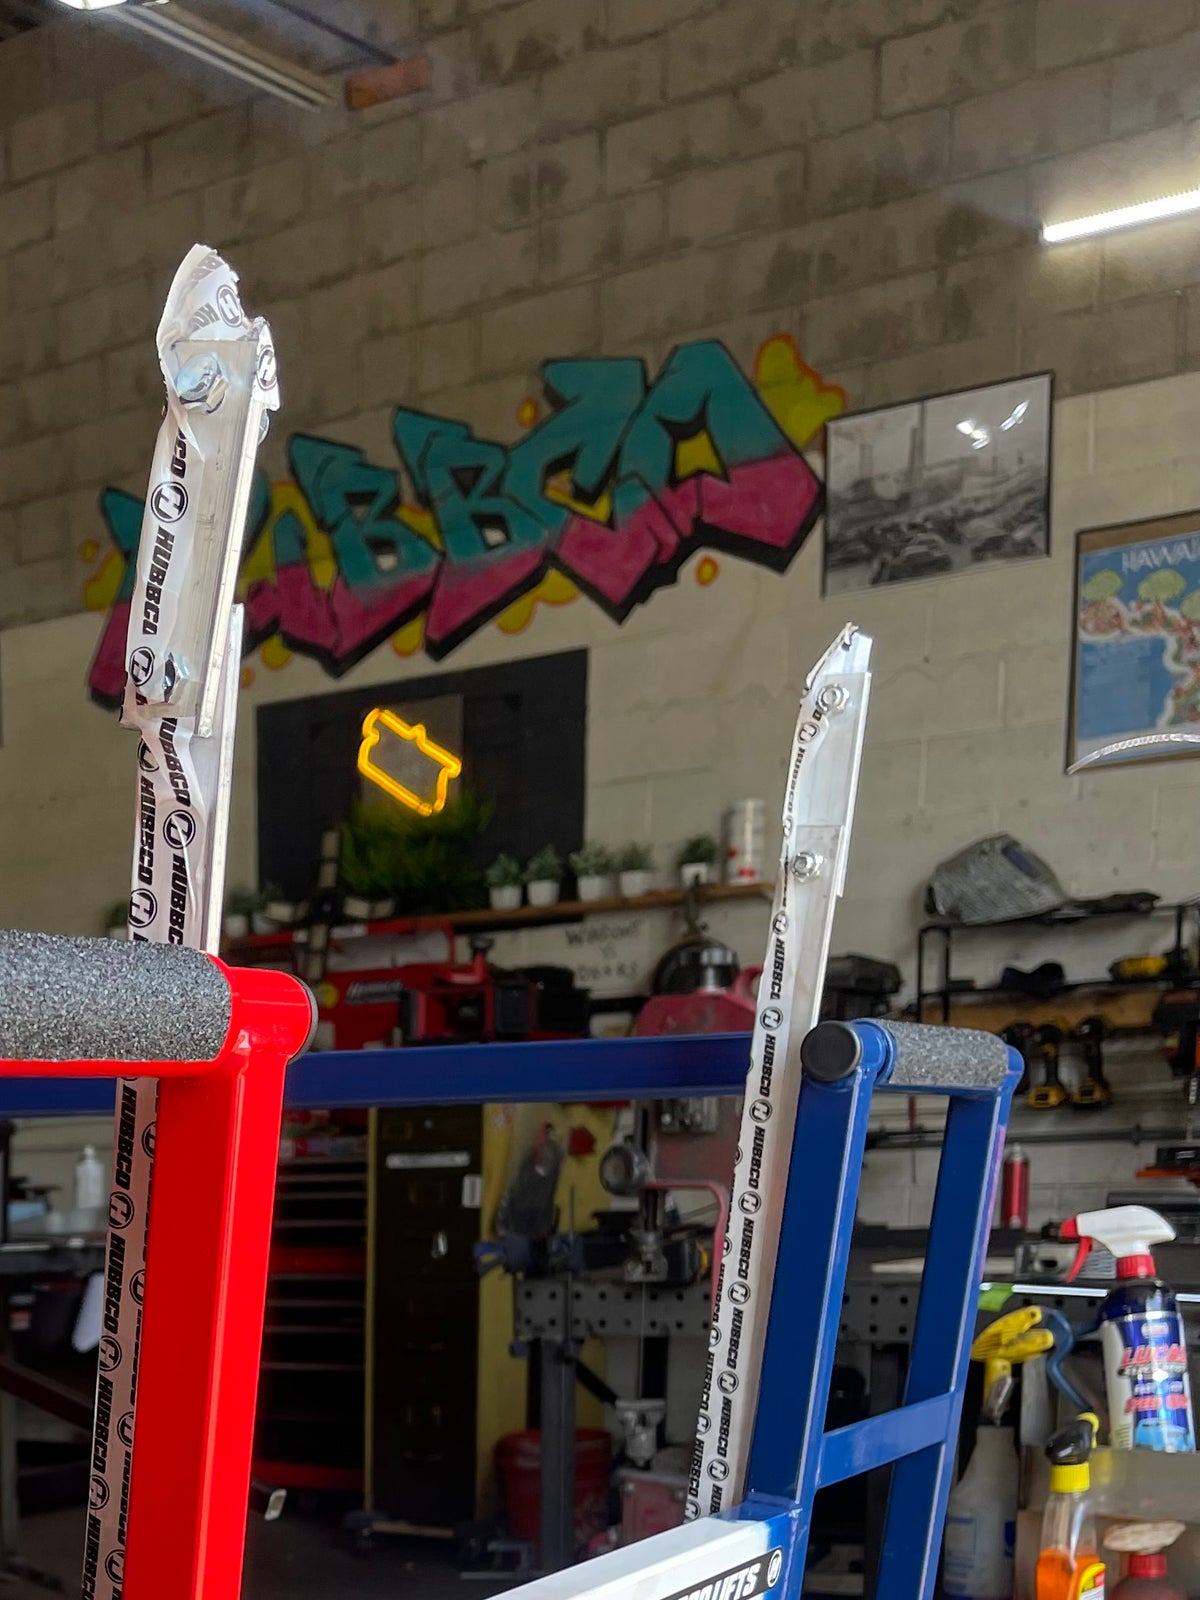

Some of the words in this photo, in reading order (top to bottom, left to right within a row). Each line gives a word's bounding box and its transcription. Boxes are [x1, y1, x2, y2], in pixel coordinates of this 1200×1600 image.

[142, 526, 175, 635] HUBBCO
[168, 854, 188, 946] HUBBC
[760, 1034, 776, 1097] HUBBCO
[115, 1083, 137, 1191] HUBBCO
[749, 1125, 765, 1189] HUBBCO
[738, 1217, 754, 1280] HUBBCO
[104, 1231, 126, 1335] HUBBCO
[727, 1307, 743, 1370] HUBBCO
[93, 1373, 113, 1475] HUBBCO
[717, 1396, 732, 1457] HUBBCO
[689, 1435, 704, 1499] HUBBCO
